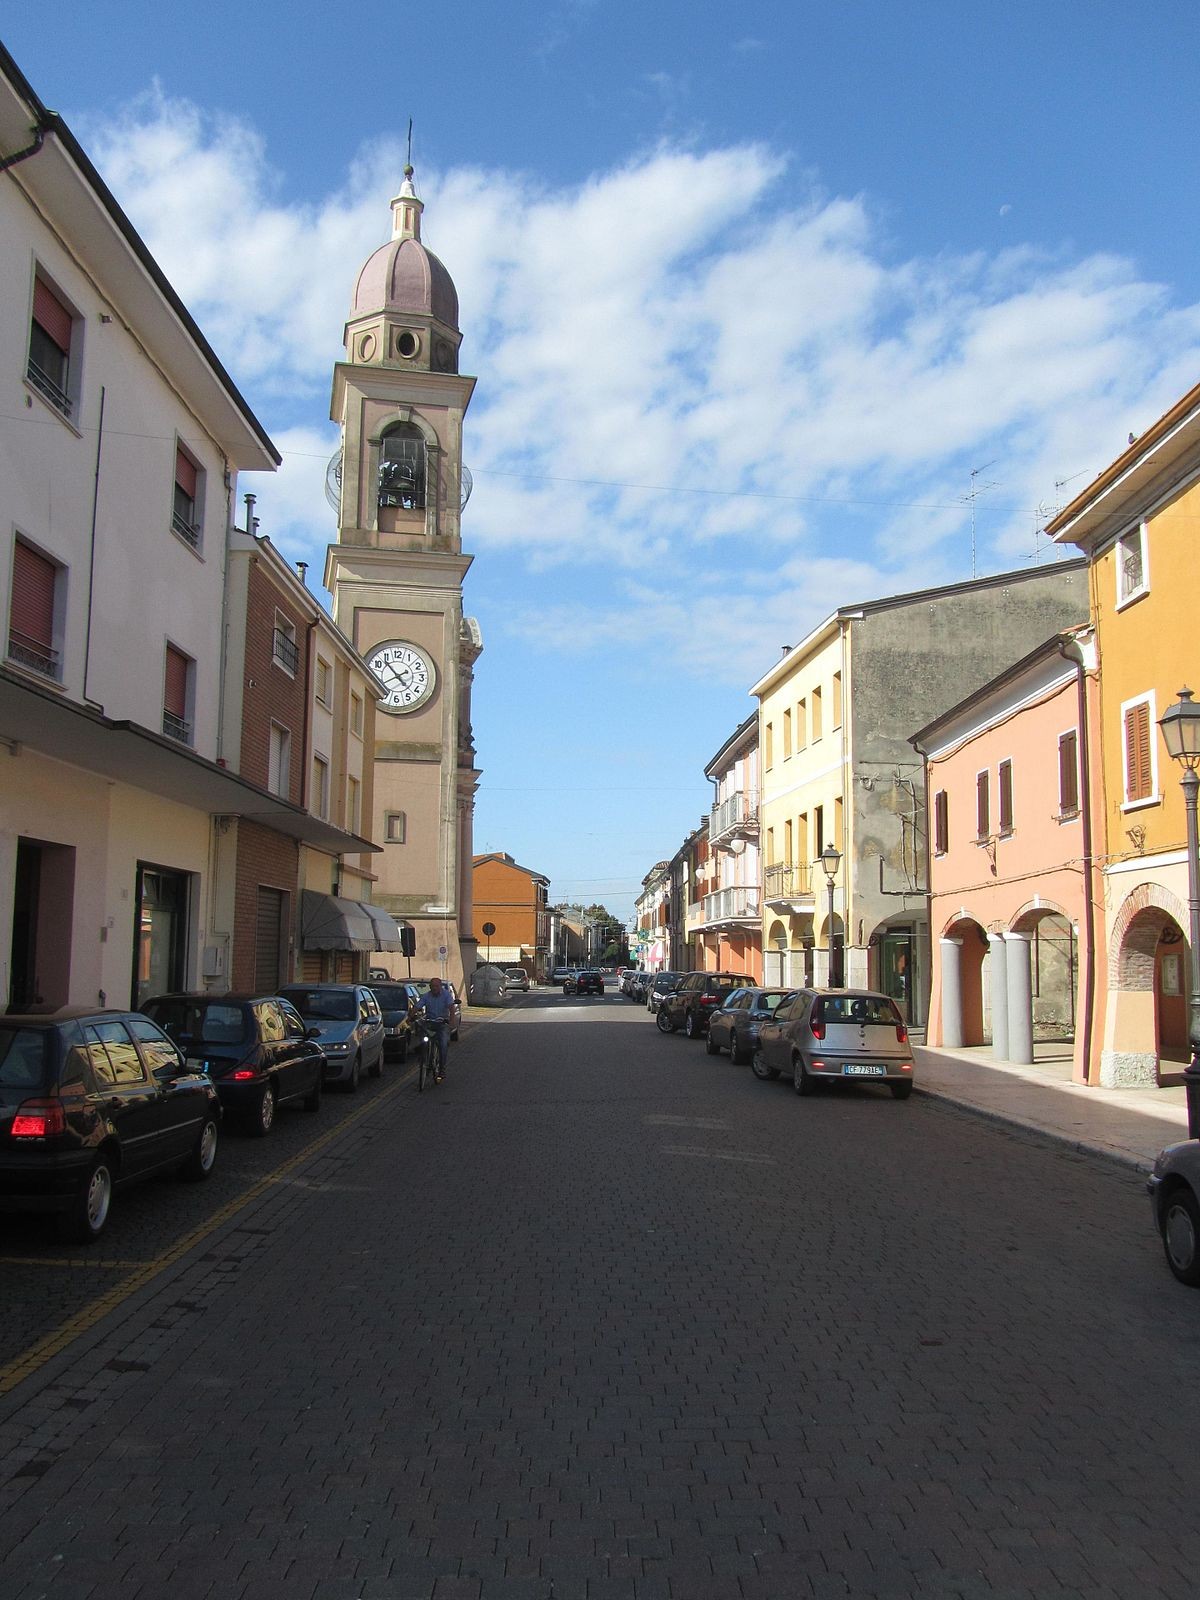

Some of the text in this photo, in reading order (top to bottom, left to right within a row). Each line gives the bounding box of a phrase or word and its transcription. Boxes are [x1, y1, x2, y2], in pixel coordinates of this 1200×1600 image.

[384, 653, 389, 661] 11
[394, 651, 402, 659] 12
[374, 660, 382, 668] 10
[416, 662, 421, 670] 2
[418, 674, 424, 682] 3
[414, 686, 420, 694] 4
[394, 695, 400, 703] 6
[405, 693, 411, 701] 5
